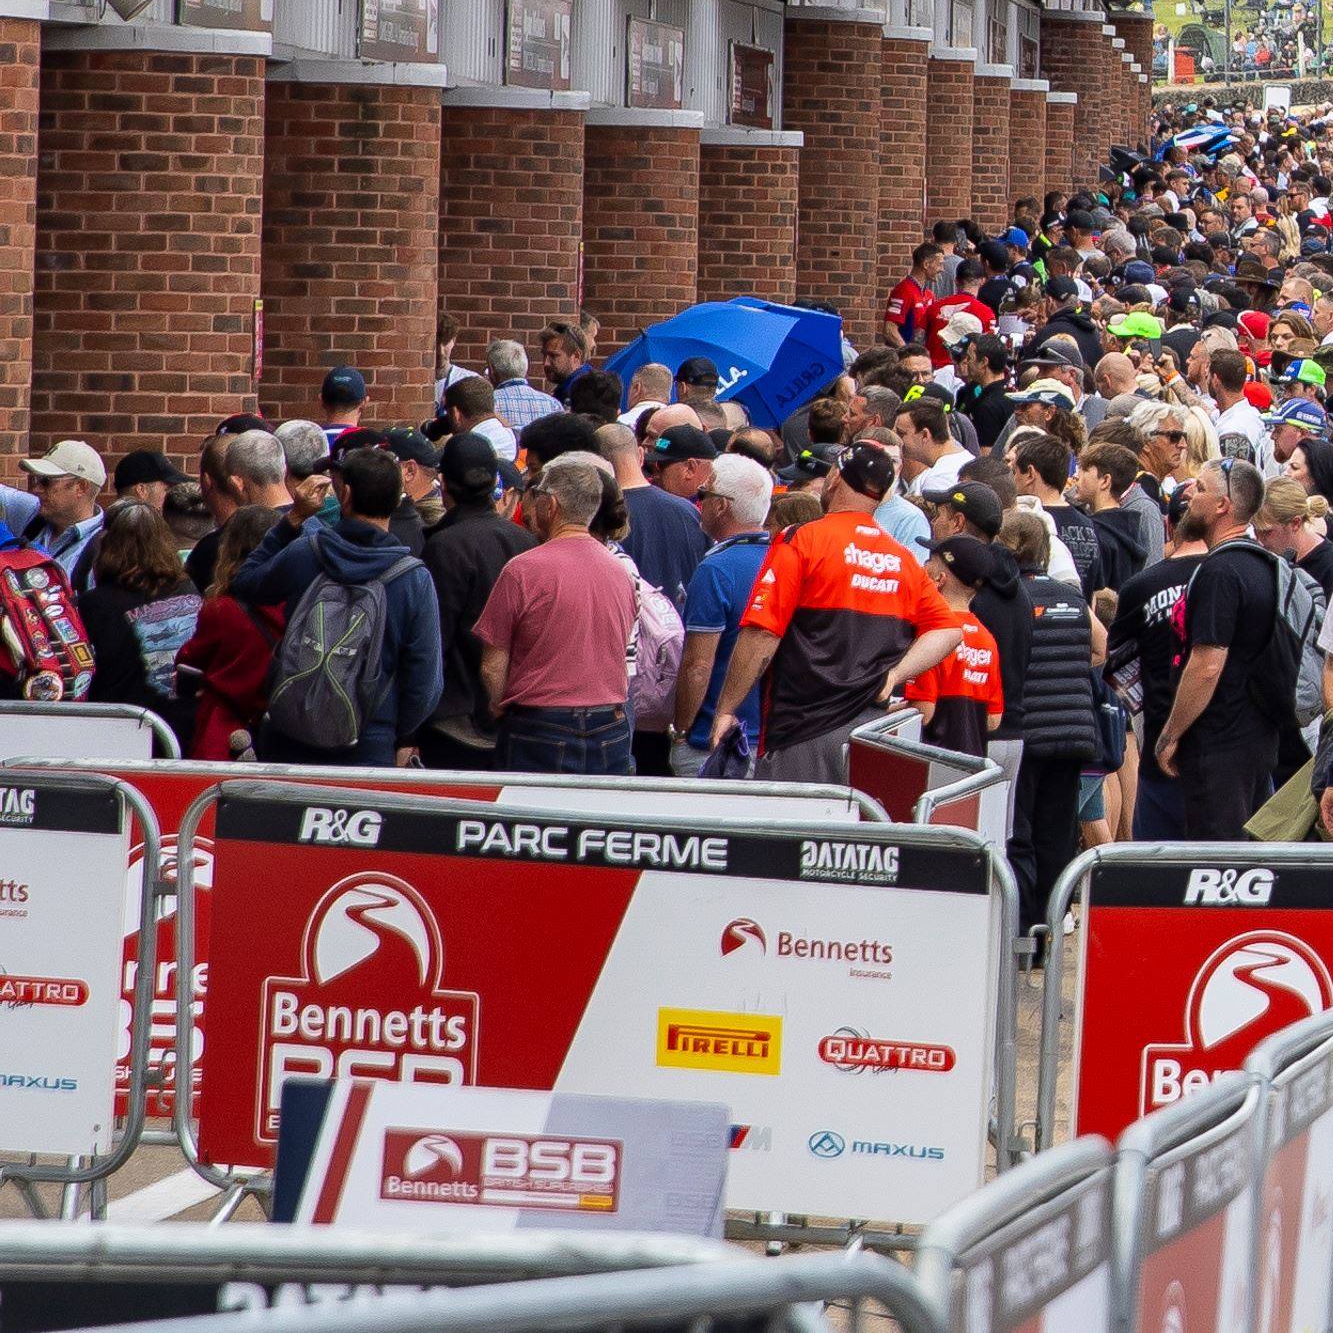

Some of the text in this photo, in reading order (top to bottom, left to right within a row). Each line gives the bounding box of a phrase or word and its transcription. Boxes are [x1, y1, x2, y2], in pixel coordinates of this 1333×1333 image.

[851, 574, 900, 594] DUCATI
[300, 807, 382, 846] R&G
[457, 819, 729, 869] PARC FERME
[800, 839, 900, 873] DATATAG
[801, 867, 898, 883] MOTORCYCLE SECURITY
[1183, 868, 1276, 907] R&G
[777, 929, 894, 965] Bennetts
[271, 990, 467, 1051] Bennetts
[667, 1023, 772, 1059] PIRELLI
[826, 1039, 946, 1067] QUATTRO
[482, 1138, 617, 1183] BSB
[851, 1139, 945, 1161] MAXUS
[387, 1174, 480, 1200] Bennetts
